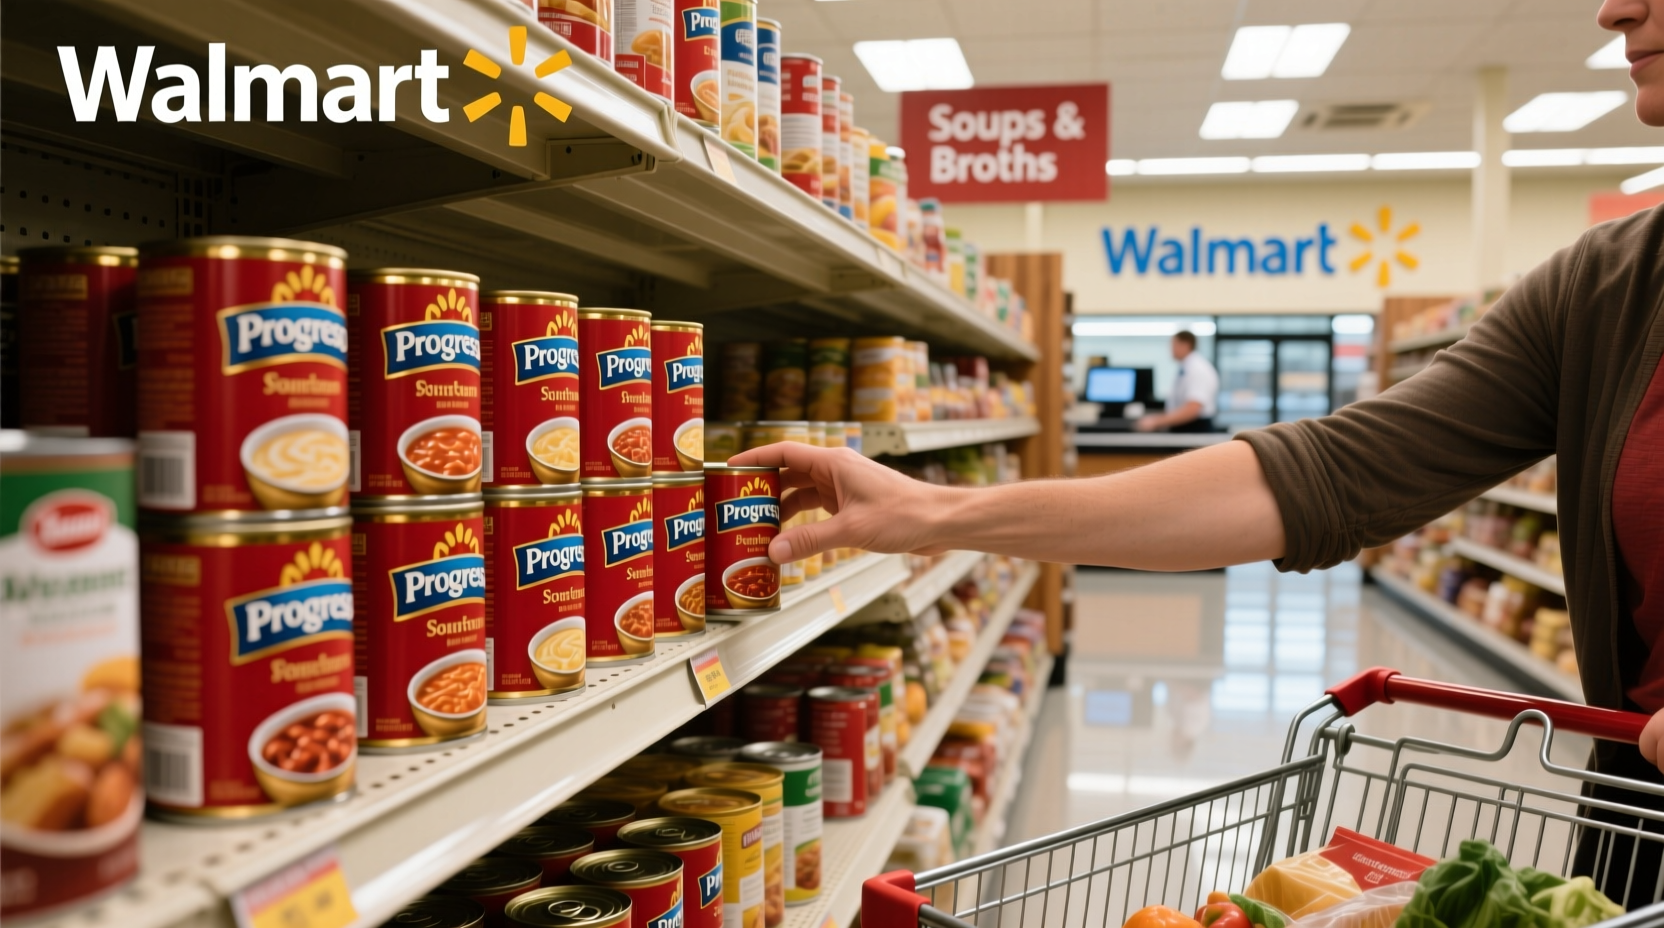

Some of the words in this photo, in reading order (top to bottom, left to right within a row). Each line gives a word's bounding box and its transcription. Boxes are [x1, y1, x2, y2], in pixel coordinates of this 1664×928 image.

[928, 102, 1046, 148] Soups
[1053, 100, 1086, 140] &
[930, 143, 1058, 184] Broths
[1101, 224, 1337, 275] Walmart
